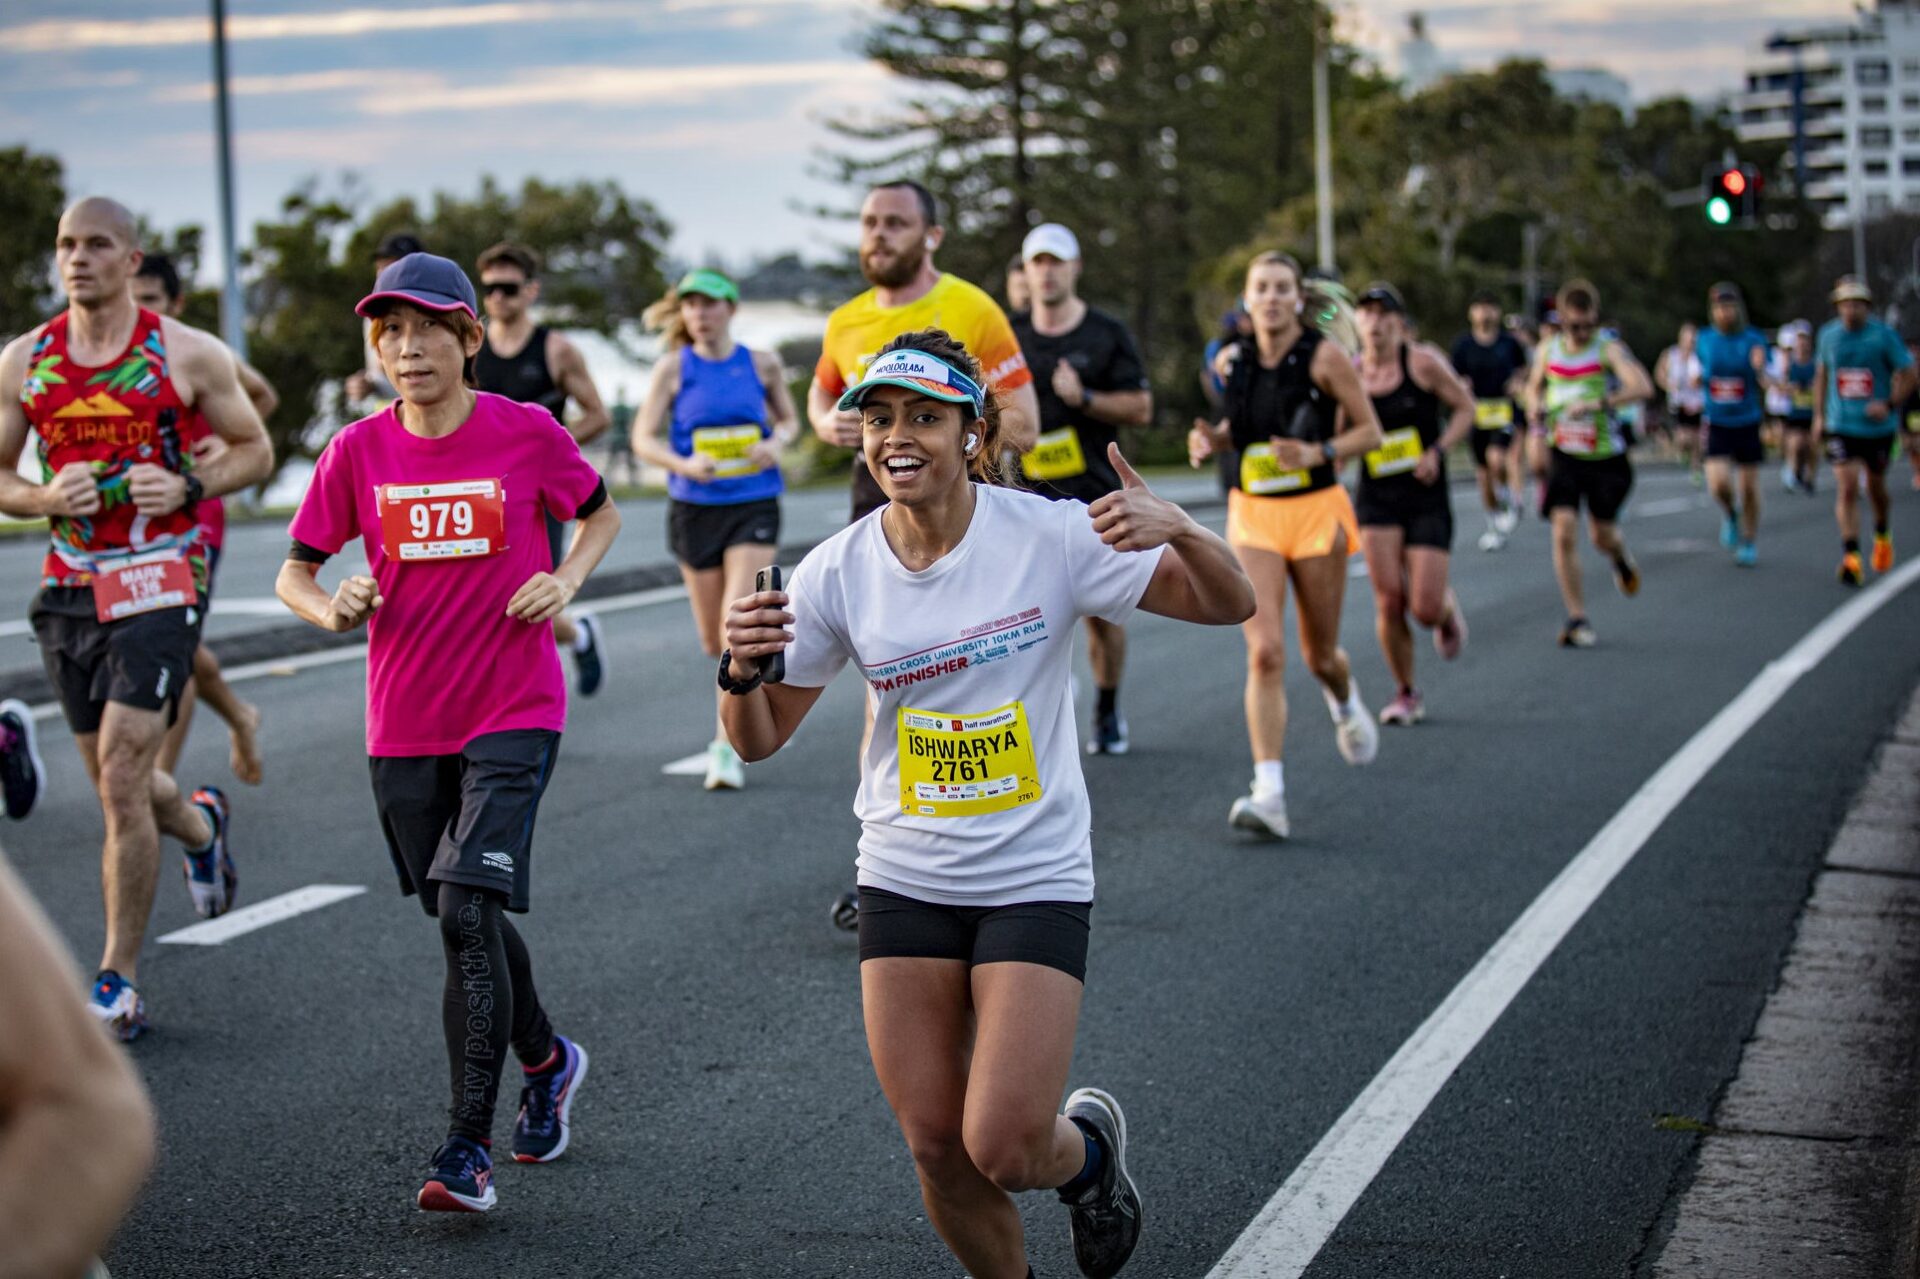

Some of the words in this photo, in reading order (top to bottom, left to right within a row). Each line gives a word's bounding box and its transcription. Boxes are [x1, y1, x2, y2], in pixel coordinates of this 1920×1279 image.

[876, 363, 925, 374] MOOLOOLABA
[410, 500, 473, 538] 979
[119, 563, 167, 587] MARK
[900, 654, 932, 671] CROSS
[934, 638, 989, 661] UNIVERSITY
[992, 630, 1021, 645] 10KM
[1023, 621, 1046, 635] RUN
[895, 656, 969, 689] FINISHER
[964, 721, 979, 729] half
[979, 712, 1012, 727] marathon
[909, 730, 1018, 759] ISHWARYA
[931, 758, 989, 782] 2761
[1017, 792, 1034, 802] 2761
[458, 893, 494, 1059] positive.
